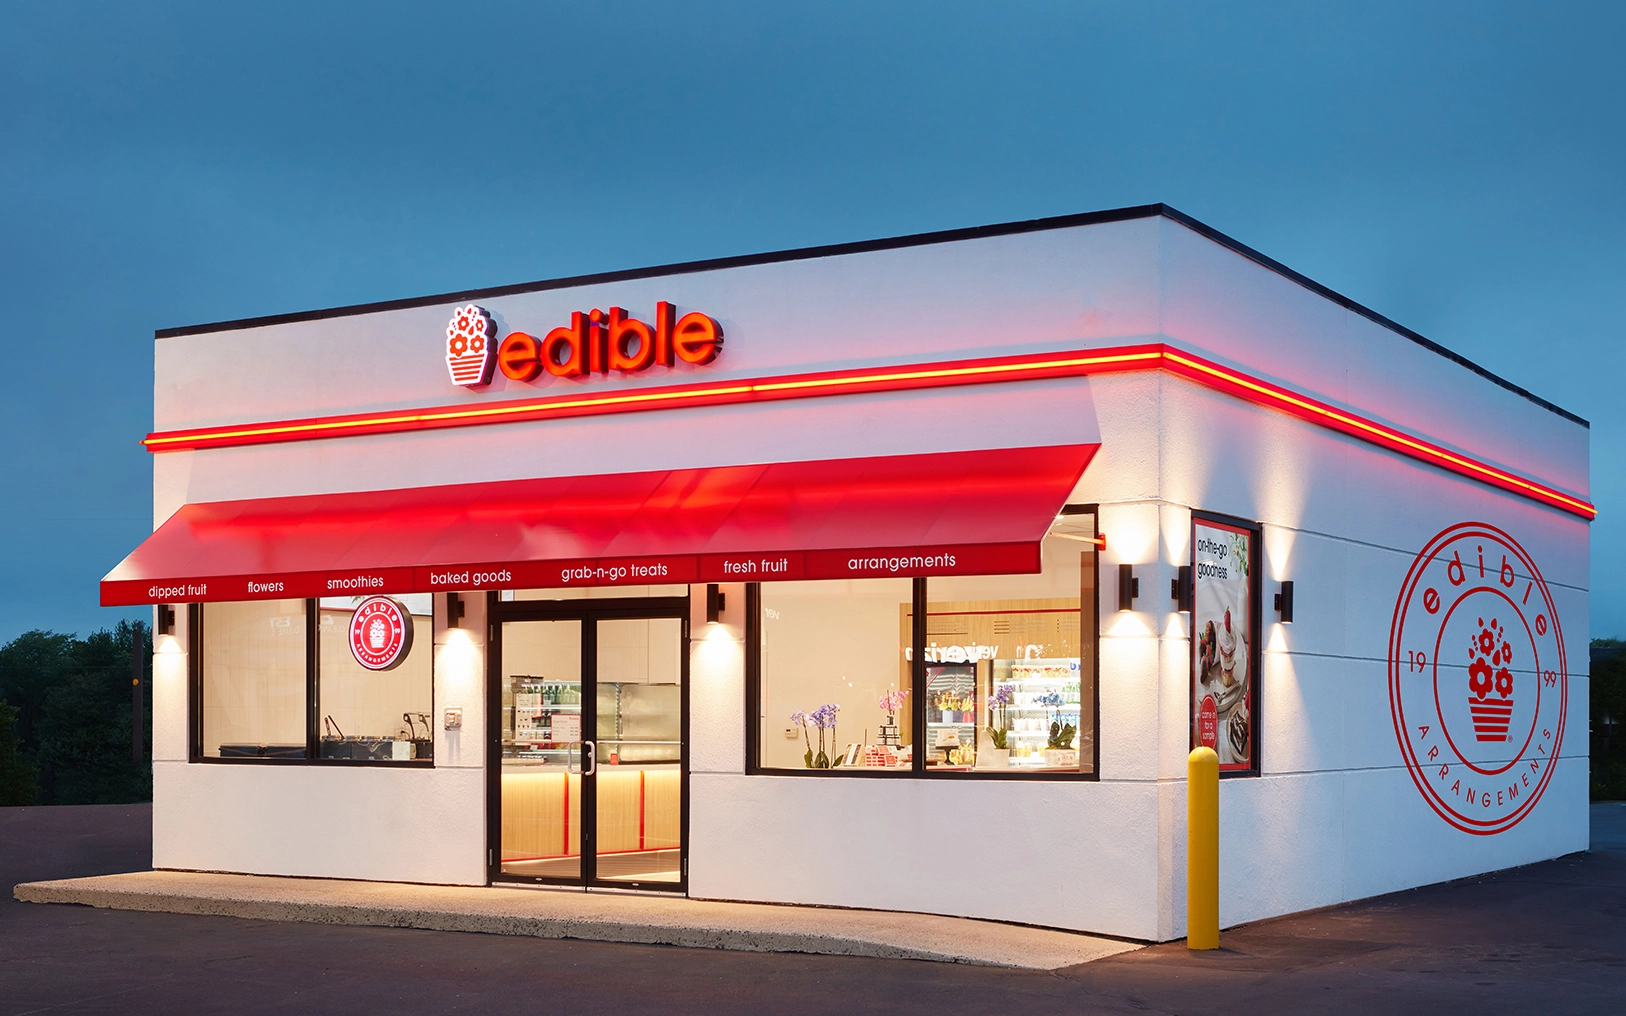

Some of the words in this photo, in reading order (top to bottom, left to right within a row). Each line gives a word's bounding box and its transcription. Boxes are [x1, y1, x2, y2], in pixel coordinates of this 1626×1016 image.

[498, 301, 724, 381] edible
[1197, 538, 1228, 560] on-the-go
[723, 559, 757, 574] fresh
[761, 558, 788, 573] fruit
[848, 553, 956, 571] arrangements
[1197, 562, 1228, 579] goodness
[430, 571, 469, 585] baked
[473, 569, 512, 586] goods
[561, 565, 627, 582] grab-n-go
[631, 563, 668, 577] treats
[148, 584, 185, 599] dipped
[188, 583, 207, 596] fruit
[247, 581, 284, 593] flowers
[327, 576, 384, 590] smoothies
[1423, 545, 1547, 636] edible
[358, 603, 397, 622] edible
[1408, 650, 1427, 673] 19
[1543, 669, 1557, 688] 99
[1418, 725, 1551, 808] ARRANGEMENTS
